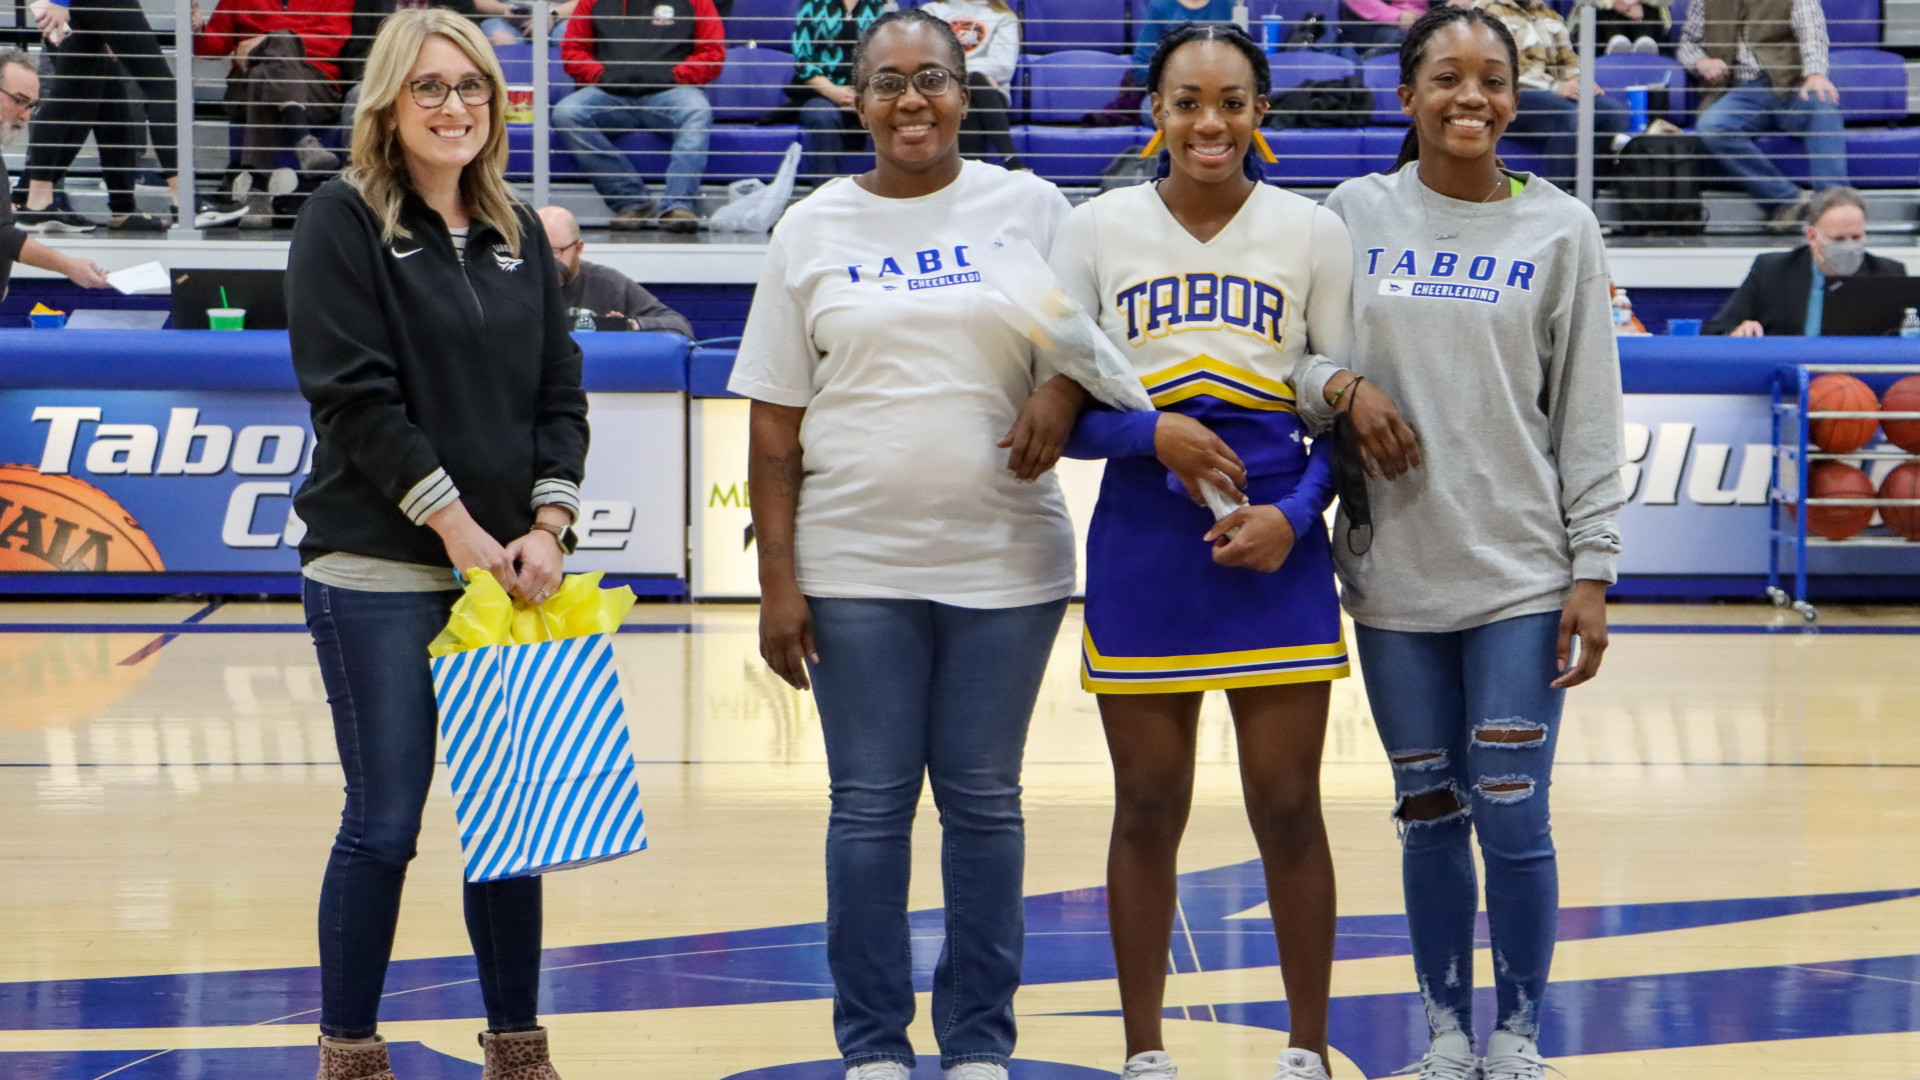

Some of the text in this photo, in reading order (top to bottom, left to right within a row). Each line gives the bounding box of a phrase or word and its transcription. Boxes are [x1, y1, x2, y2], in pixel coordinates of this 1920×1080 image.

[908, 271, 981, 291] CHEERLEADI
[1366, 247, 1537, 293] TABOR
[1413, 283, 1498, 302] CHEERLEADING
[1116, 272, 1290, 352] TABOR
